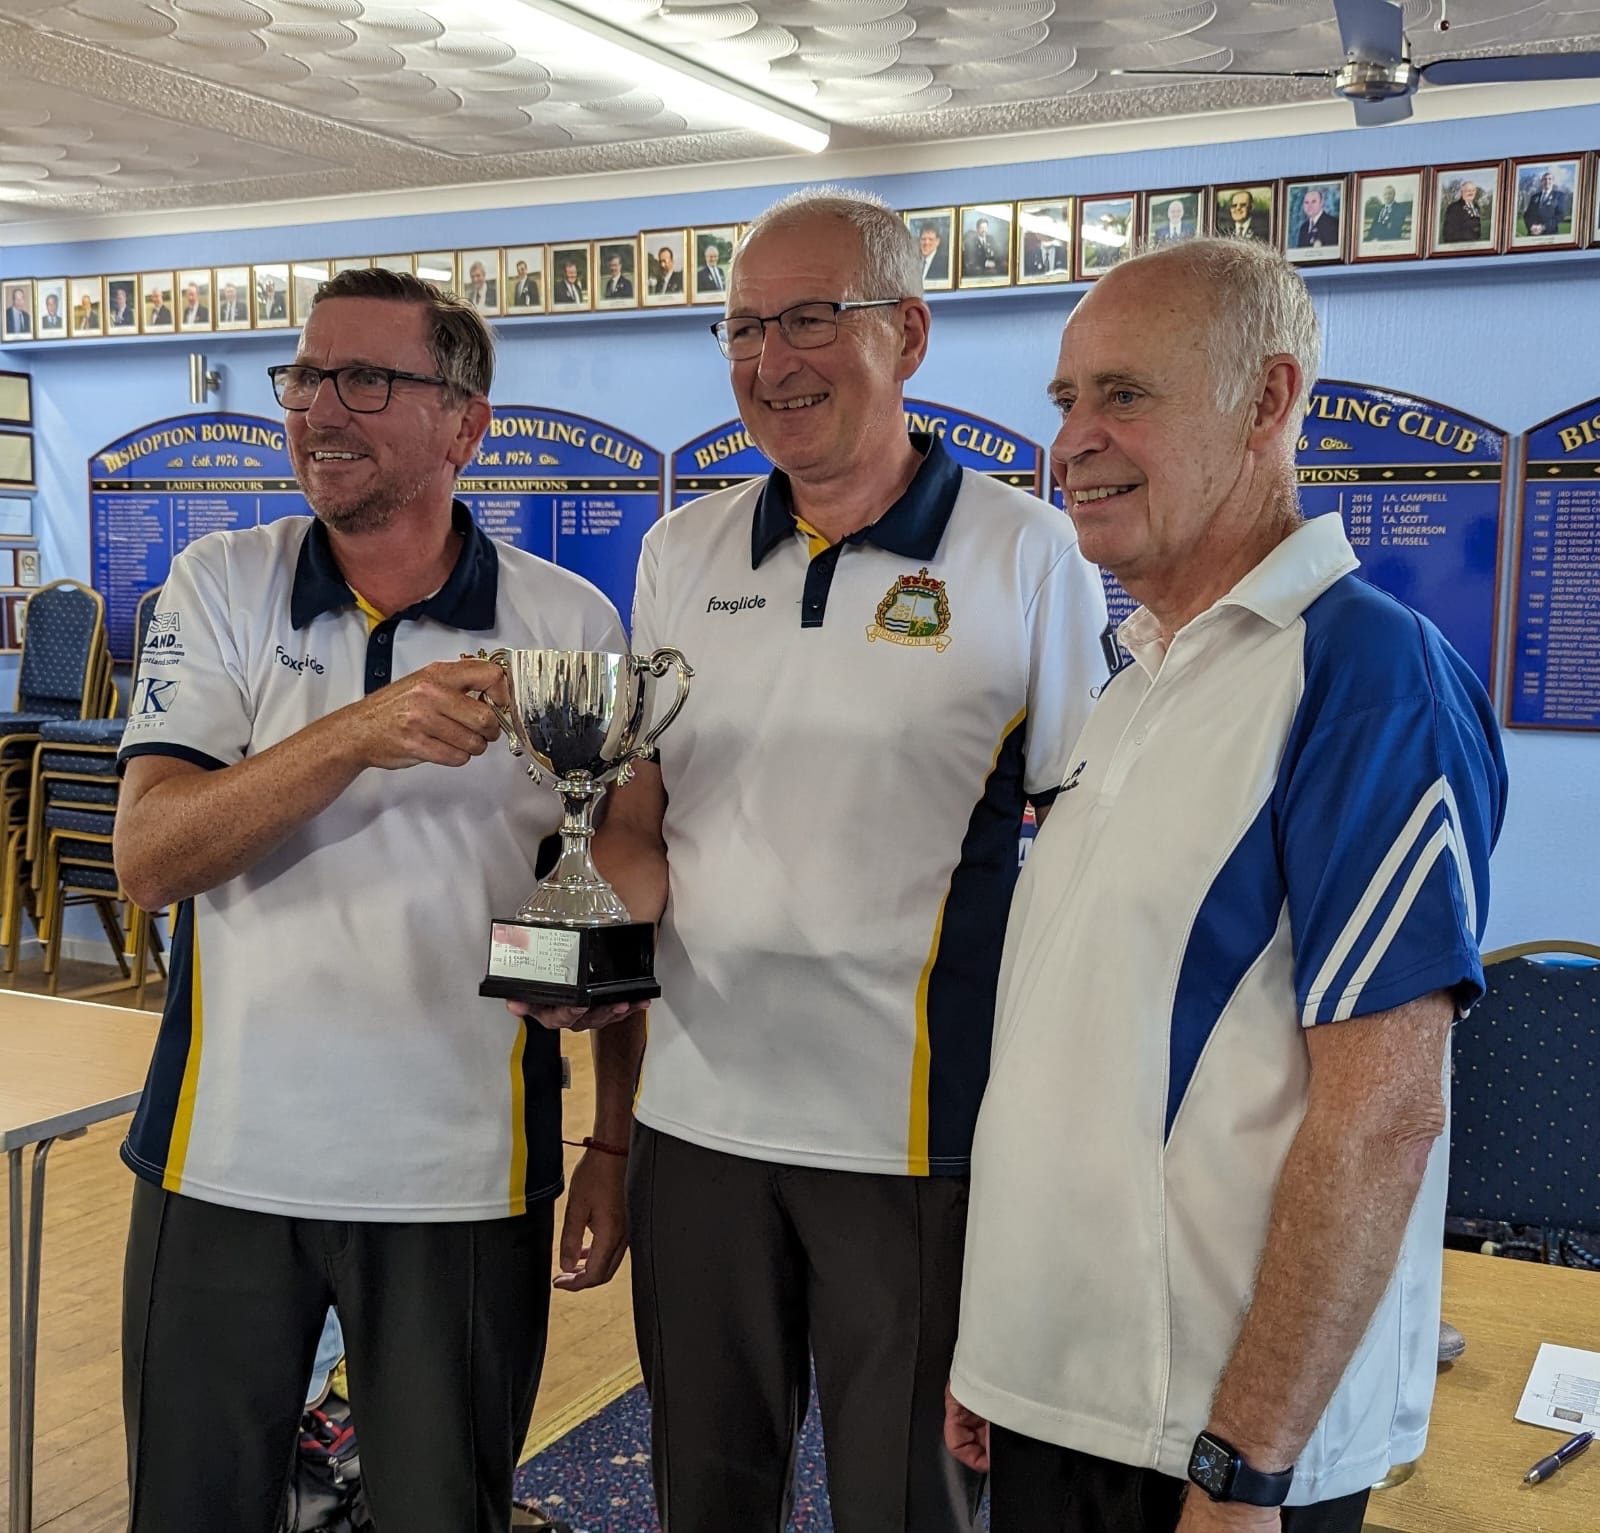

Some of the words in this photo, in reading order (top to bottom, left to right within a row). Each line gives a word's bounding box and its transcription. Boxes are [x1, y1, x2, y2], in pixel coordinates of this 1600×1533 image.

[1398, 411, 1478, 453] CLUB
[103, 426, 197, 474] BISHOPTON
[201, 423, 284, 450] BOWLING
[490, 417, 586, 448] BOWLING
[590, 434, 644, 470] CLUB
[952, 424, 1016, 464] CLUB
[215, 454, 239, 467] 1976
[505, 451, 532, 465] 1976
[1297, 470, 1360, 482] PIONS
[166, 481, 204, 491] LADIES
[206, 481, 264, 491] HONOURS
[456, 480, 486, 491] DIES
[488, 480, 568, 491] CHAMPIONS
[1351, 494, 1372, 503] 2016
[1383, 494, 1397, 502] J.A.
[1400, 494, 1448, 502] CAMPBELL
[1351, 505, 1372, 513] 2017
[1394, 505, 1421, 513] EADIE
[1350, 516, 1371, 524] 2018
[1381, 516, 1397, 524] T.A.
[1400, 515, 1429, 524] SCOTT
[1350, 526, 1371, 535] 2019
[1381, 526, 1389, 534] L.
[1390, 526, 1446, 535] HENDERSON
[1350, 537, 1370, 546] 2022
[1380, 537, 1390, 545] G.
[1392, 537, 1429, 546] RUSSELL
[706, 594, 767, 615] foxglide
[150, 612, 181, 633] SEA
[145, 634, 176, 649] AND
[873, 626, 921, 645] BISHOPTON
[274, 645, 325, 676] foxgide
